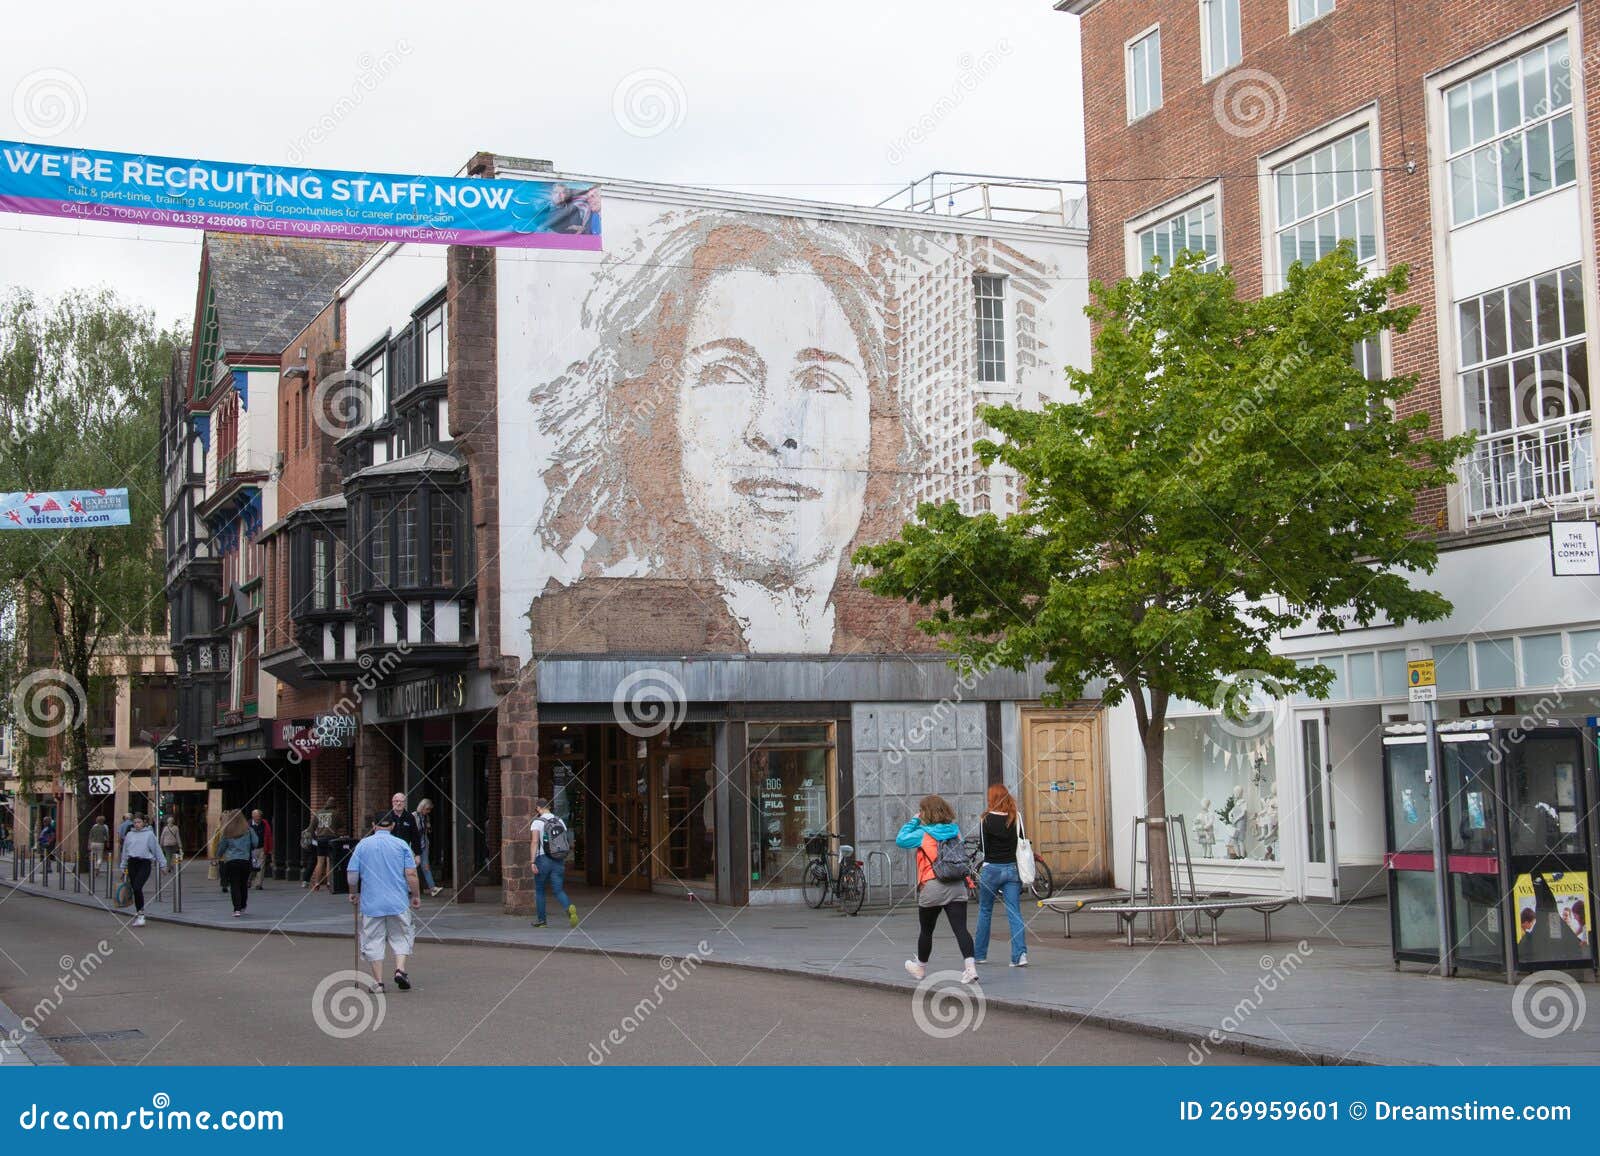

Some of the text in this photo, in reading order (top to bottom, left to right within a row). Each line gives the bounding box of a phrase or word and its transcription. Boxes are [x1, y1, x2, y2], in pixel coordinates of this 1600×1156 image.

[3, 149, 513, 210] WE'RE RECRUITING STAFF NOW
[67, 185, 88, 197] Full
[90, 188, 98, 197] &
[156, 194, 195, 207] training
[199, 197, 206, 206] &
[253, 202, 273, 212] and
[276, 205, 343, 219] opportunities
[346, 207, 359, 217] for
[361, 211, 394, 219] career
[395, 212, 455, 224] progression
[61, 203, 460, 240] CALL US TODAY ON 01392 426006 TO GET YOUR APPLICATION UNDER WAY
[26, 513, 110, 524] visitexeter.com
[316, 714, 356, 727] URBAN
[317, 726, 357, 737] OUTFIT
[320, 735, 342, 747] TERS
[90, 777, 111, 793] &S
[767, 778, 782, 790] BDG
[1519, 882, 1585, 894] WASTONES
